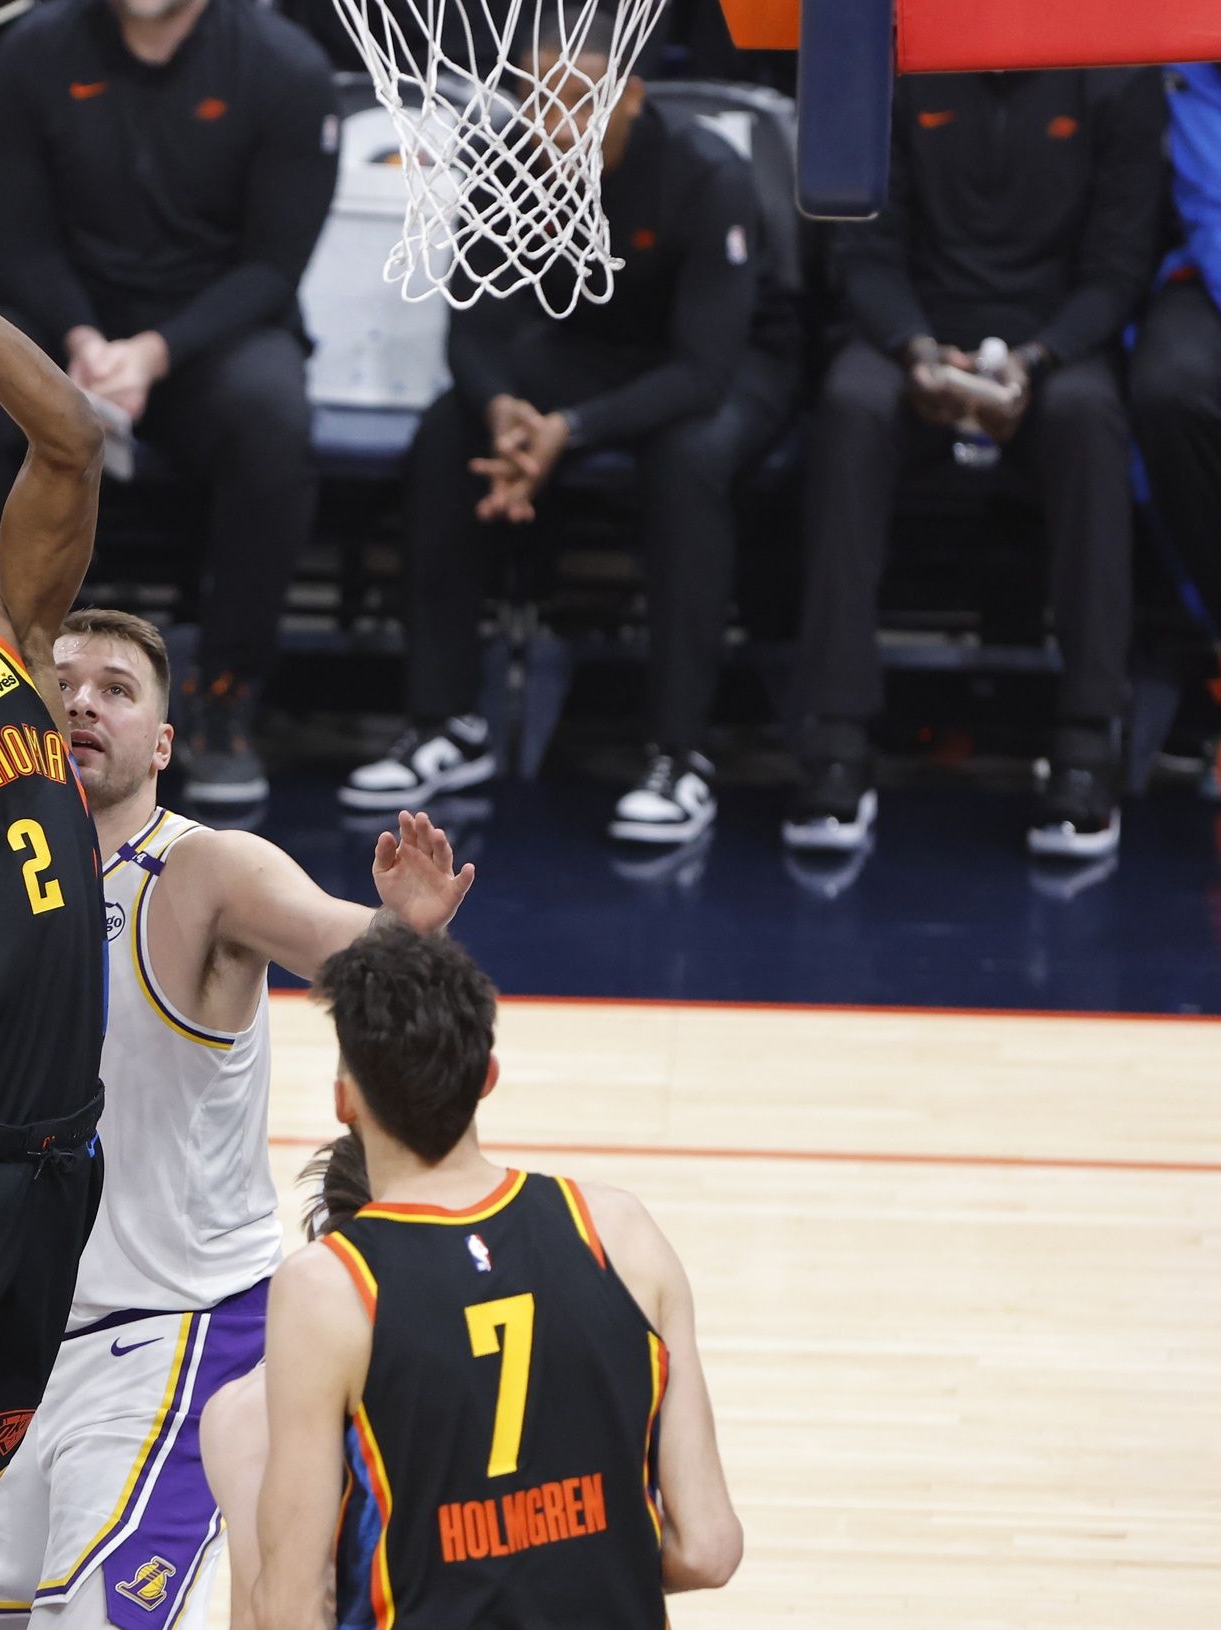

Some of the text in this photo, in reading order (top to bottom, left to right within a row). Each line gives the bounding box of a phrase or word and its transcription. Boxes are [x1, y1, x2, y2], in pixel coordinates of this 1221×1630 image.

[7, 818, 66, 915] 2
[464, 1292, 535, 1478] 7
[438, 1472, 607, 1563] HOLMGREN
